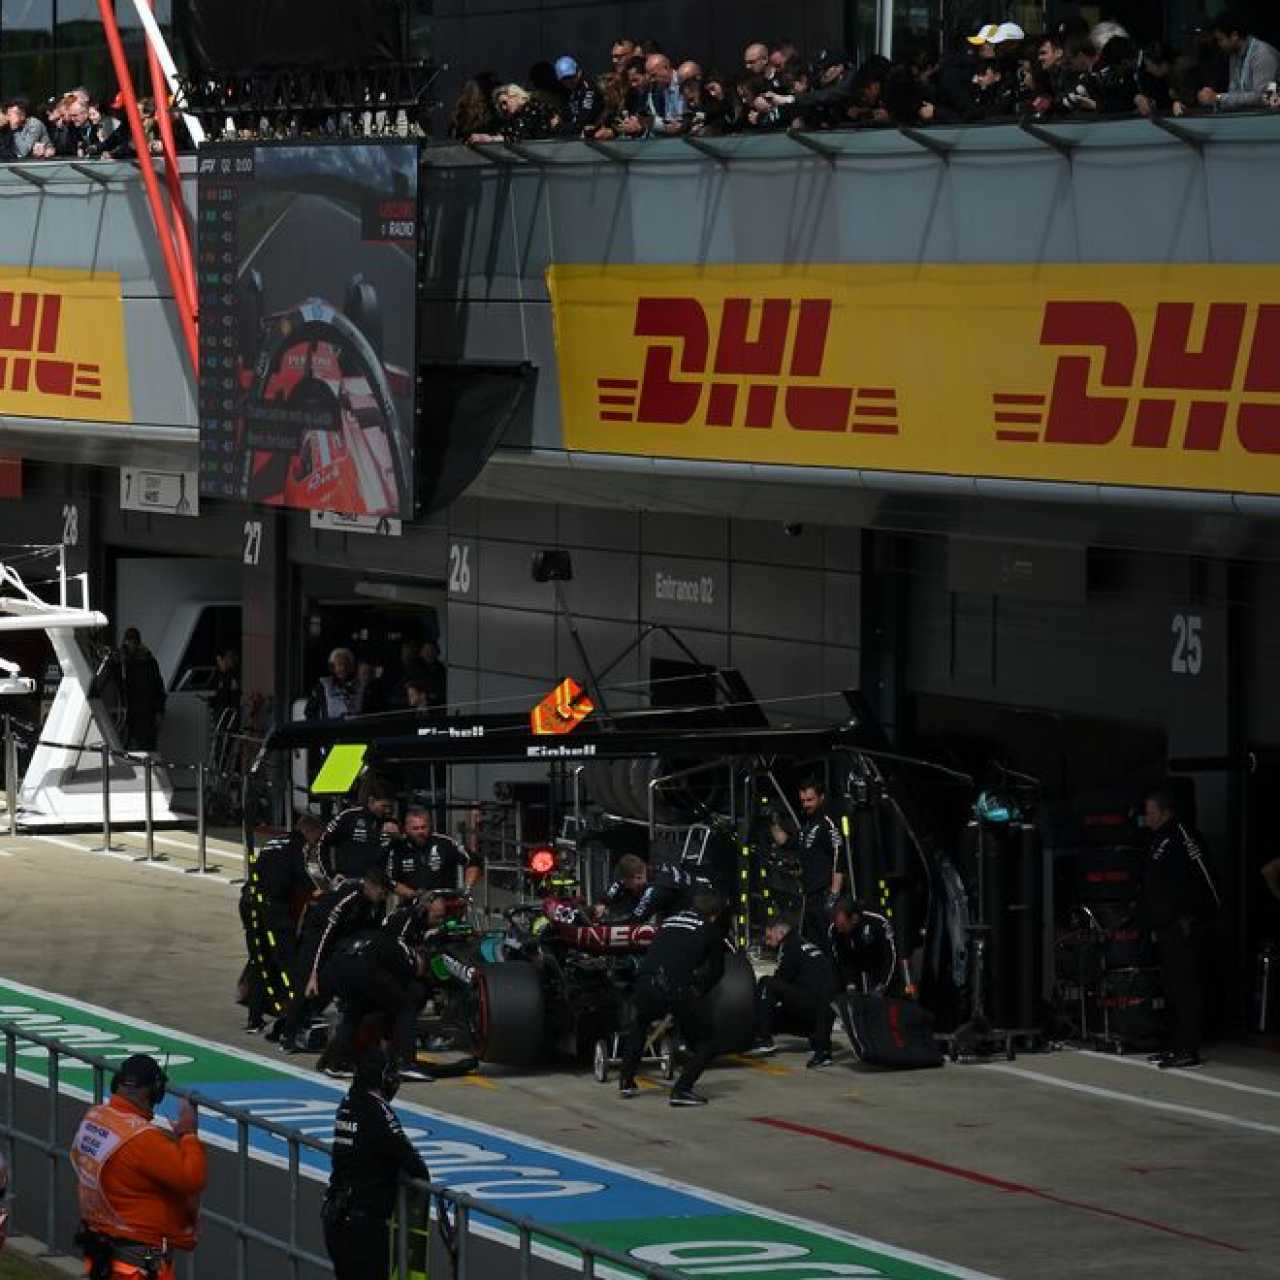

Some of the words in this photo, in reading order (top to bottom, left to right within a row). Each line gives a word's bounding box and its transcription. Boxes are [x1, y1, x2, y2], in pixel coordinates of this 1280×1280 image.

[633, 296, 854, 435] DHL
[63, 503, 79, 546] 28
[242, 521, 263, 565] 27
[449, 545, 471, 593] 26
[655, 572, 699, 601] Entrance
[1170, 613, 1203, 676] 25
[526, 744, 597, 757] Einhell
[577, 925, 658, 947] INEO
